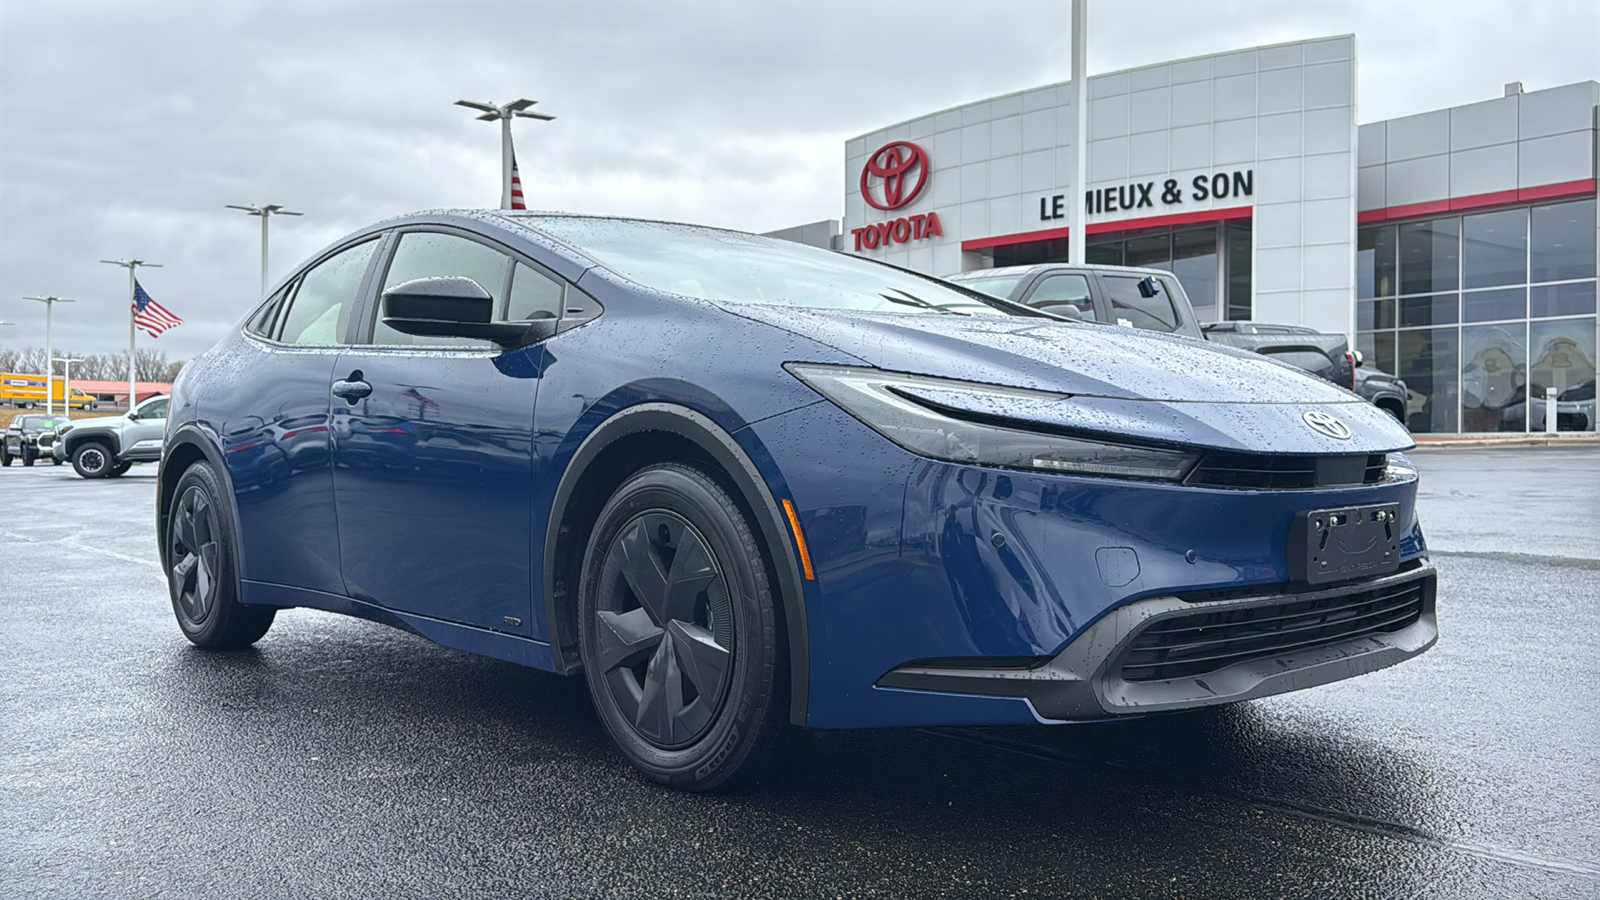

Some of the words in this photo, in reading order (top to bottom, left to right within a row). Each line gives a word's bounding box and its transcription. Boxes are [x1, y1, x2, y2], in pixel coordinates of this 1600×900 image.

[1040, 194, 1064, 221] LE
[1161, 179, 1182, 204] &
[1191, 170, 1253, 200] SON
[851, 212, 942, 252] TOYOTA
